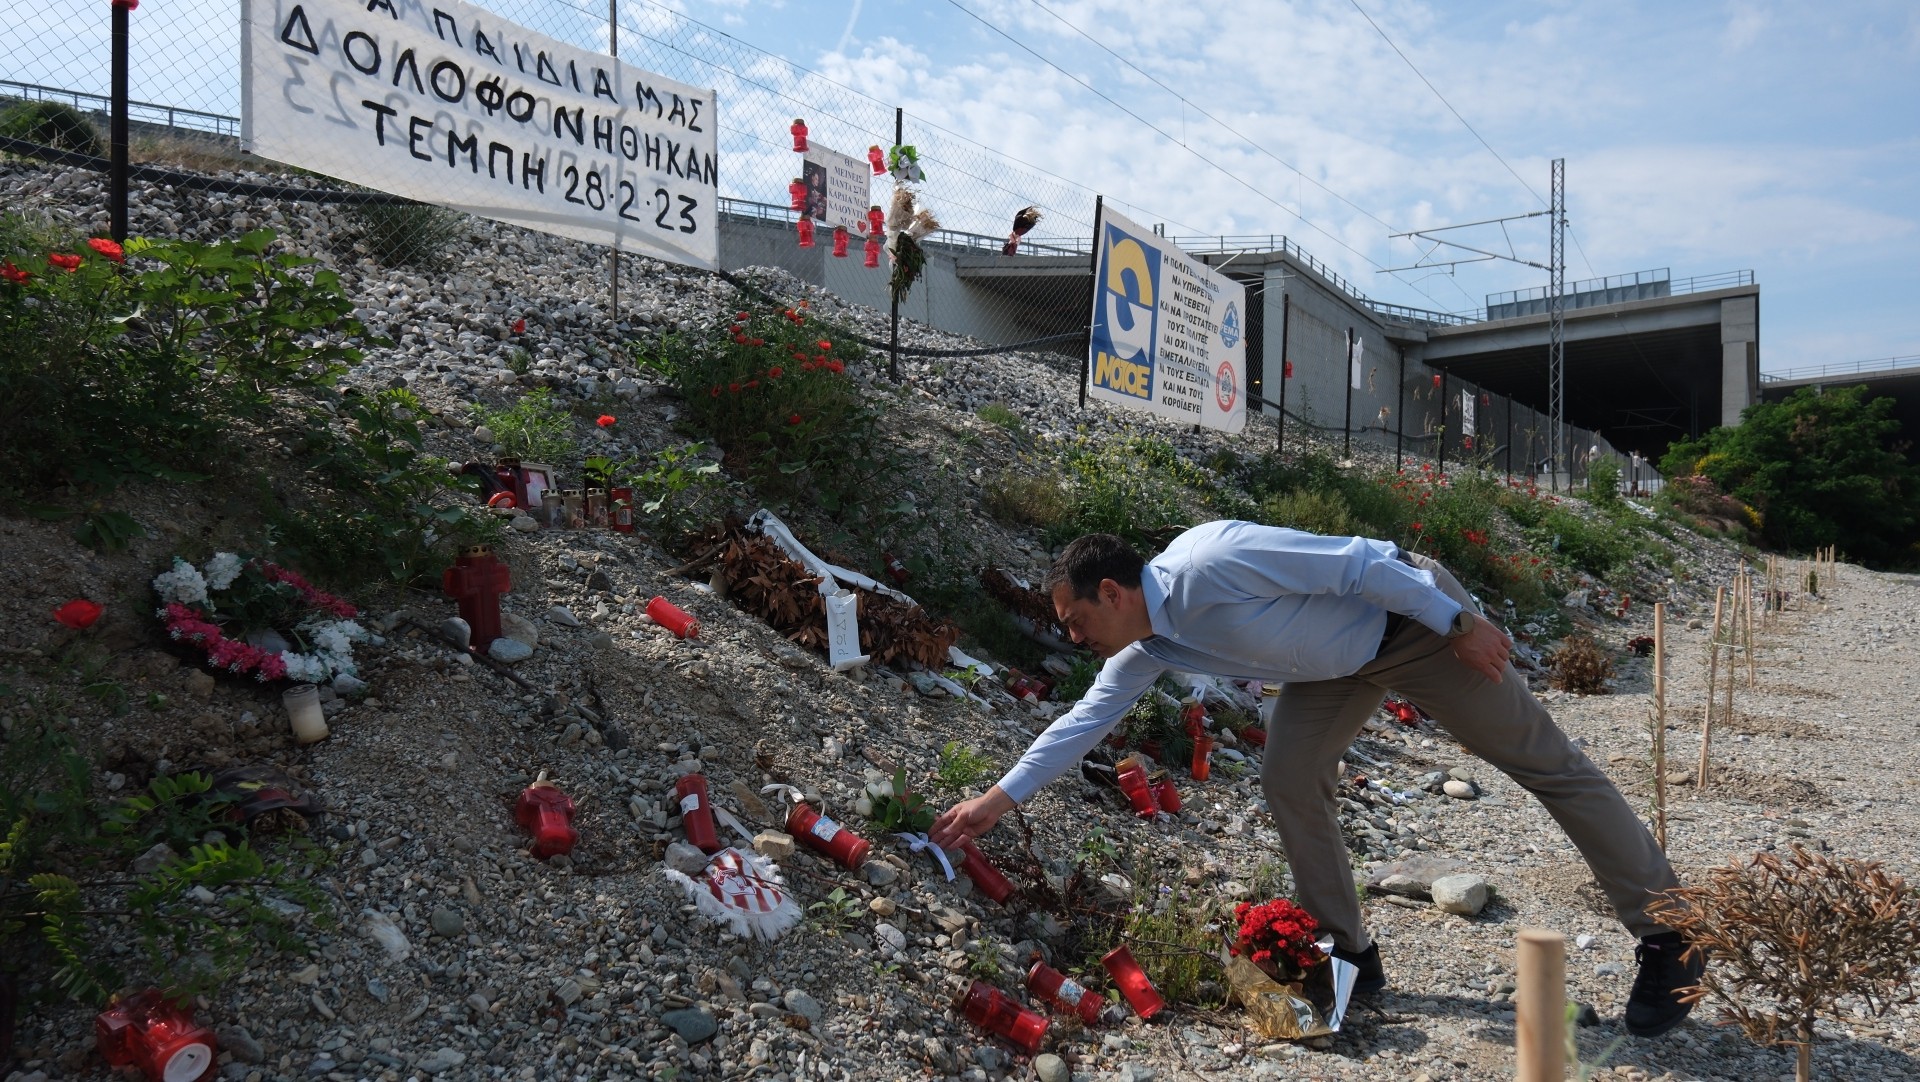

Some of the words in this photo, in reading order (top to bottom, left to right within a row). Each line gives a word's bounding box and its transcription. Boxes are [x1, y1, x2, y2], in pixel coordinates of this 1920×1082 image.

[433, 8, 617, 104] ΠΑΙΔΙΑ
[635, 81, 703, 133] ΜΑΣ
[281, 5, 718, 188] ΔΟΛΟΦΟΝΗΘΗΚΑΝ
[362, 100, 545, 194] ΤΕΜΠΗ
[1170, 306, 1181, 317] ΝΑ
[1184, 296, 1211, 316] ΣΕΒΕΤΑΙ
[1167, 320, 1185, 334] ΤΟΥΣ
[1174, 338, 1188, 350] ΟΧΙ
[1166, 366, 1184, 380] ΤΟΥΣ
[1163, 380, 1175, 392] ΚΑΙ
[1176, 384, 1187, 396] ΝΑ
[1189, 387, 1204, 401] ΤΟΥΣ
